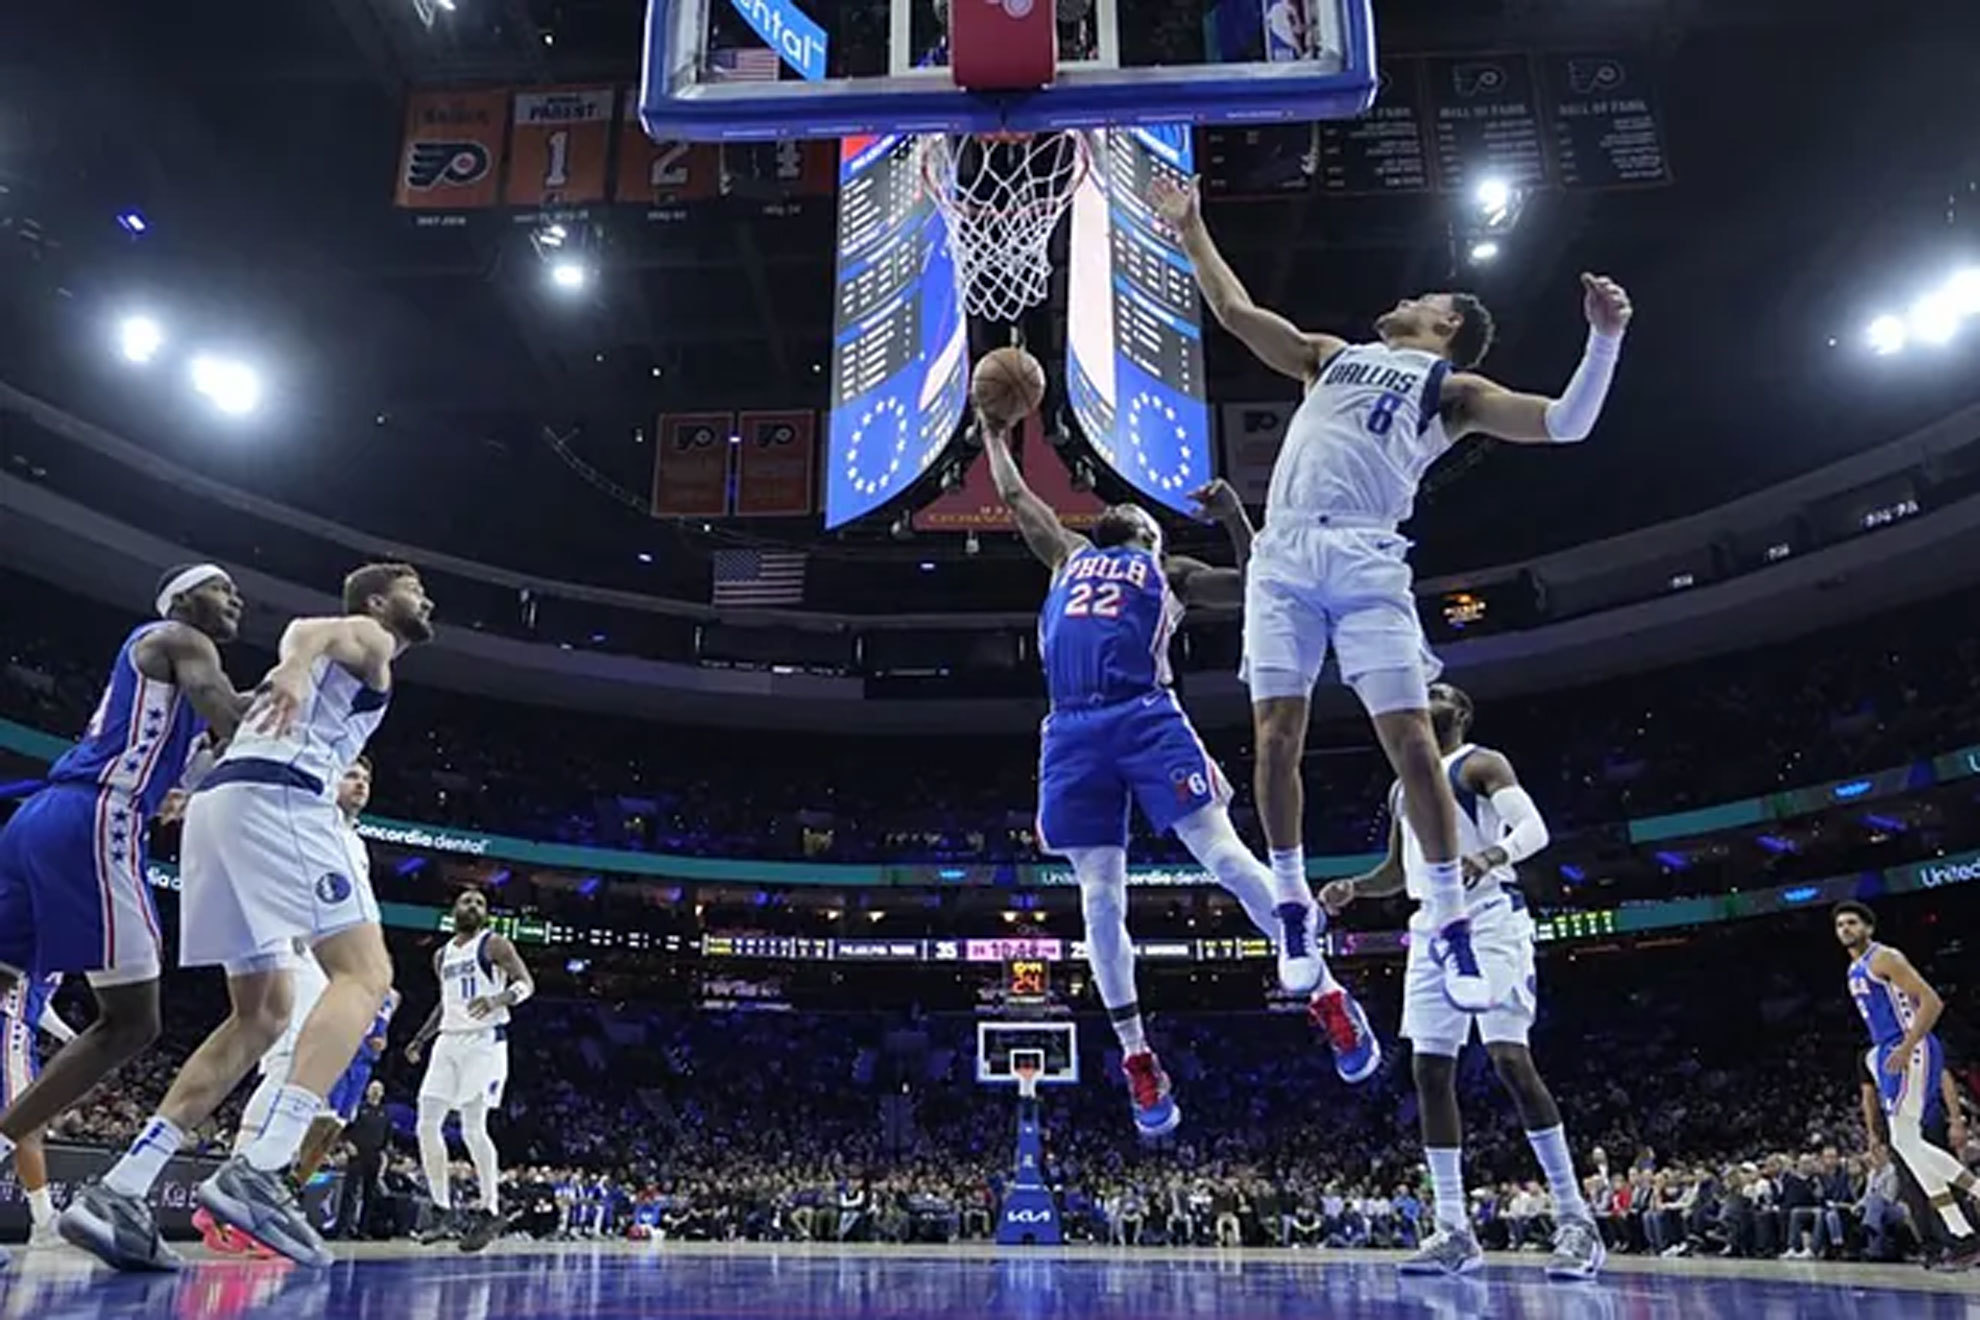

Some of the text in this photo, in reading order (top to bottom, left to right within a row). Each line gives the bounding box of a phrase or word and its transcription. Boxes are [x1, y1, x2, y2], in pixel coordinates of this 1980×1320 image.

[543, 131, 571, 190] 1
[1324, 363, 1418, 394] DALLAS
[1366, 391, 1402, 436] 8
[1067, 555, 1148, 589] PHILA
[1064, 582, 1122, 617] 22
